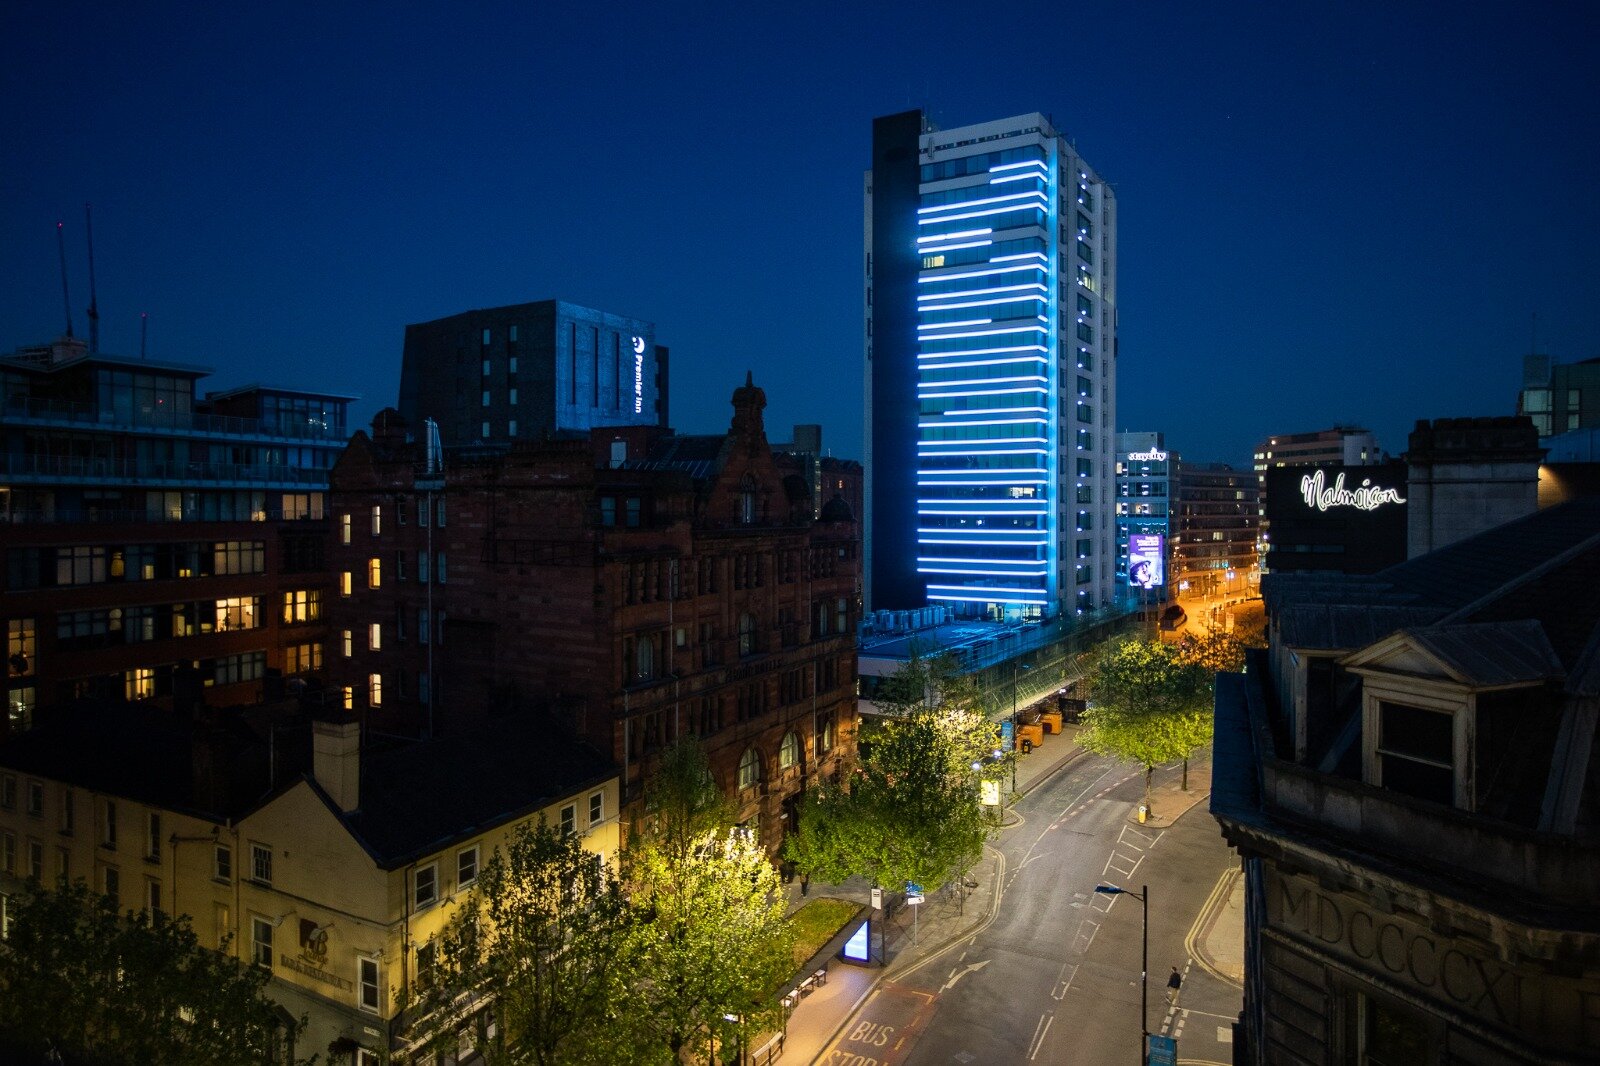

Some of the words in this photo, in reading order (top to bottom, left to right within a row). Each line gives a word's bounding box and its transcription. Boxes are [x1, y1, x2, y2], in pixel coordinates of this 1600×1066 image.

[635, 354, 643, 397] Premier
[635, 397, 643, 414] Inn
[1128, 448, 1167, 462] staycity
[1301, 470, 1406, 511] Malmaison
[849, 1021, 894, 1046] BUS
